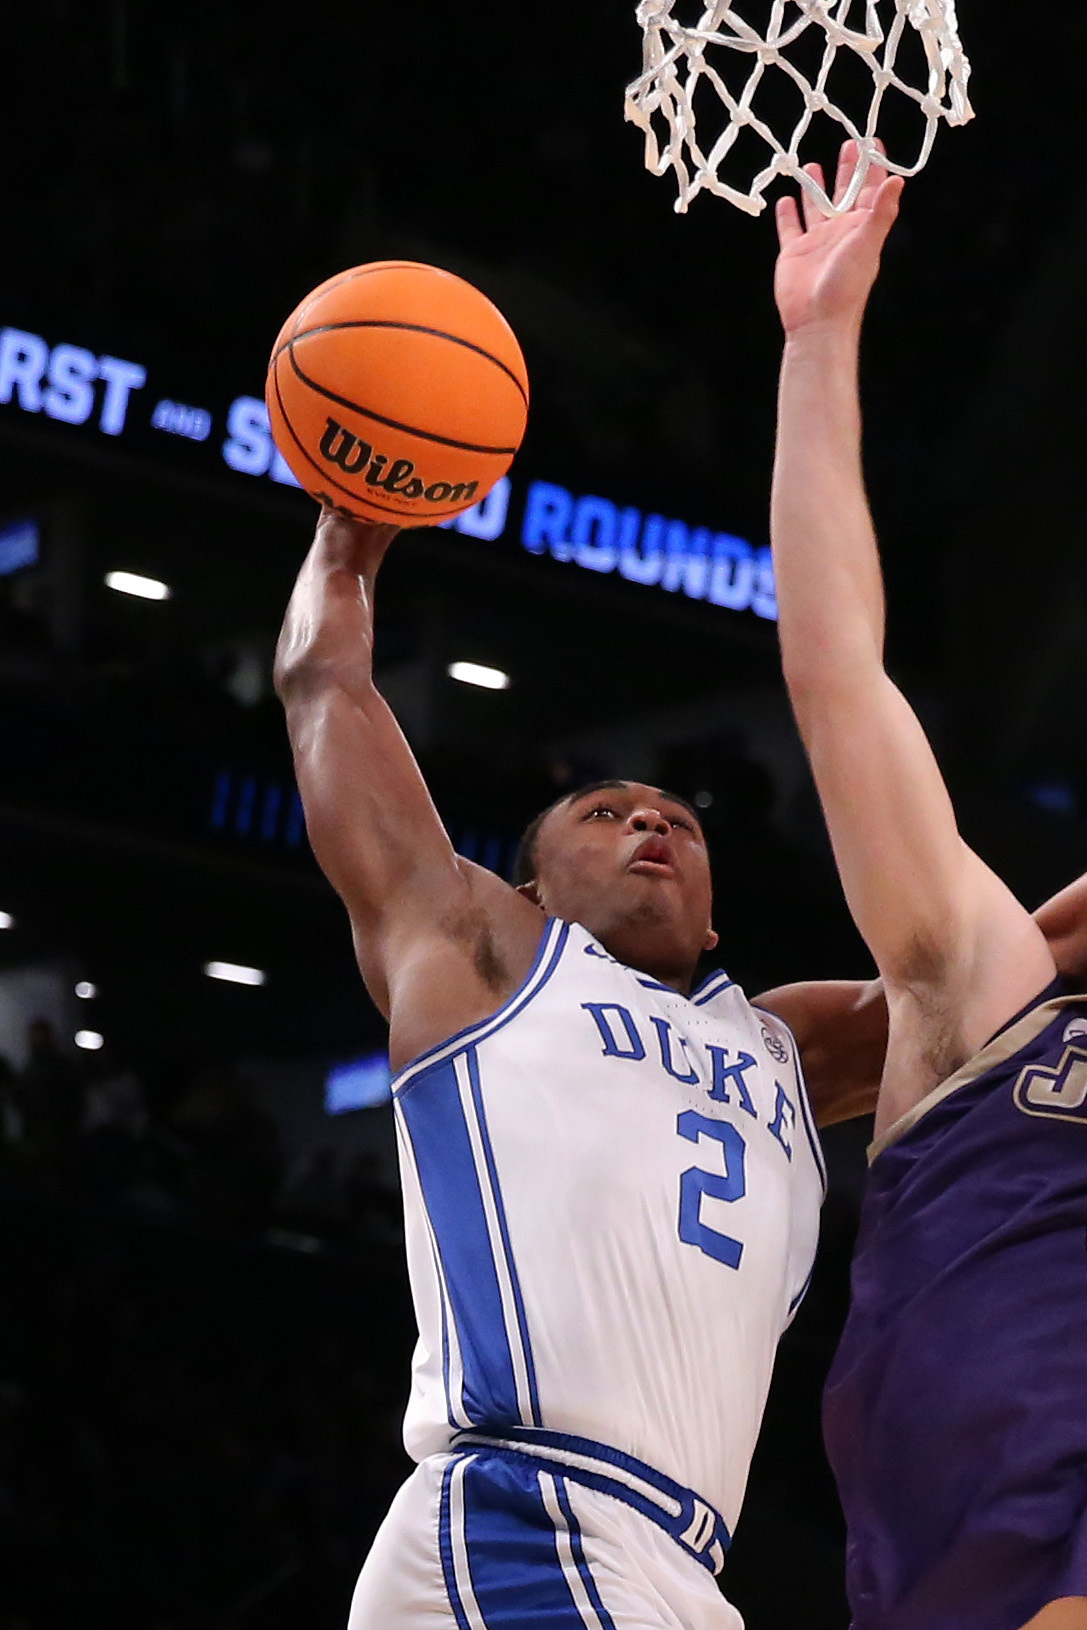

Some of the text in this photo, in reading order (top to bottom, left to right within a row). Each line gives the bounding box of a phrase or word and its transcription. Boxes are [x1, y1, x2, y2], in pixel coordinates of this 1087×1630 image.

[319, 416, 480, 503] Wilson
[581, 1003, 796, 1163] DUKE
[676, 1109, 746, 1271] 2
